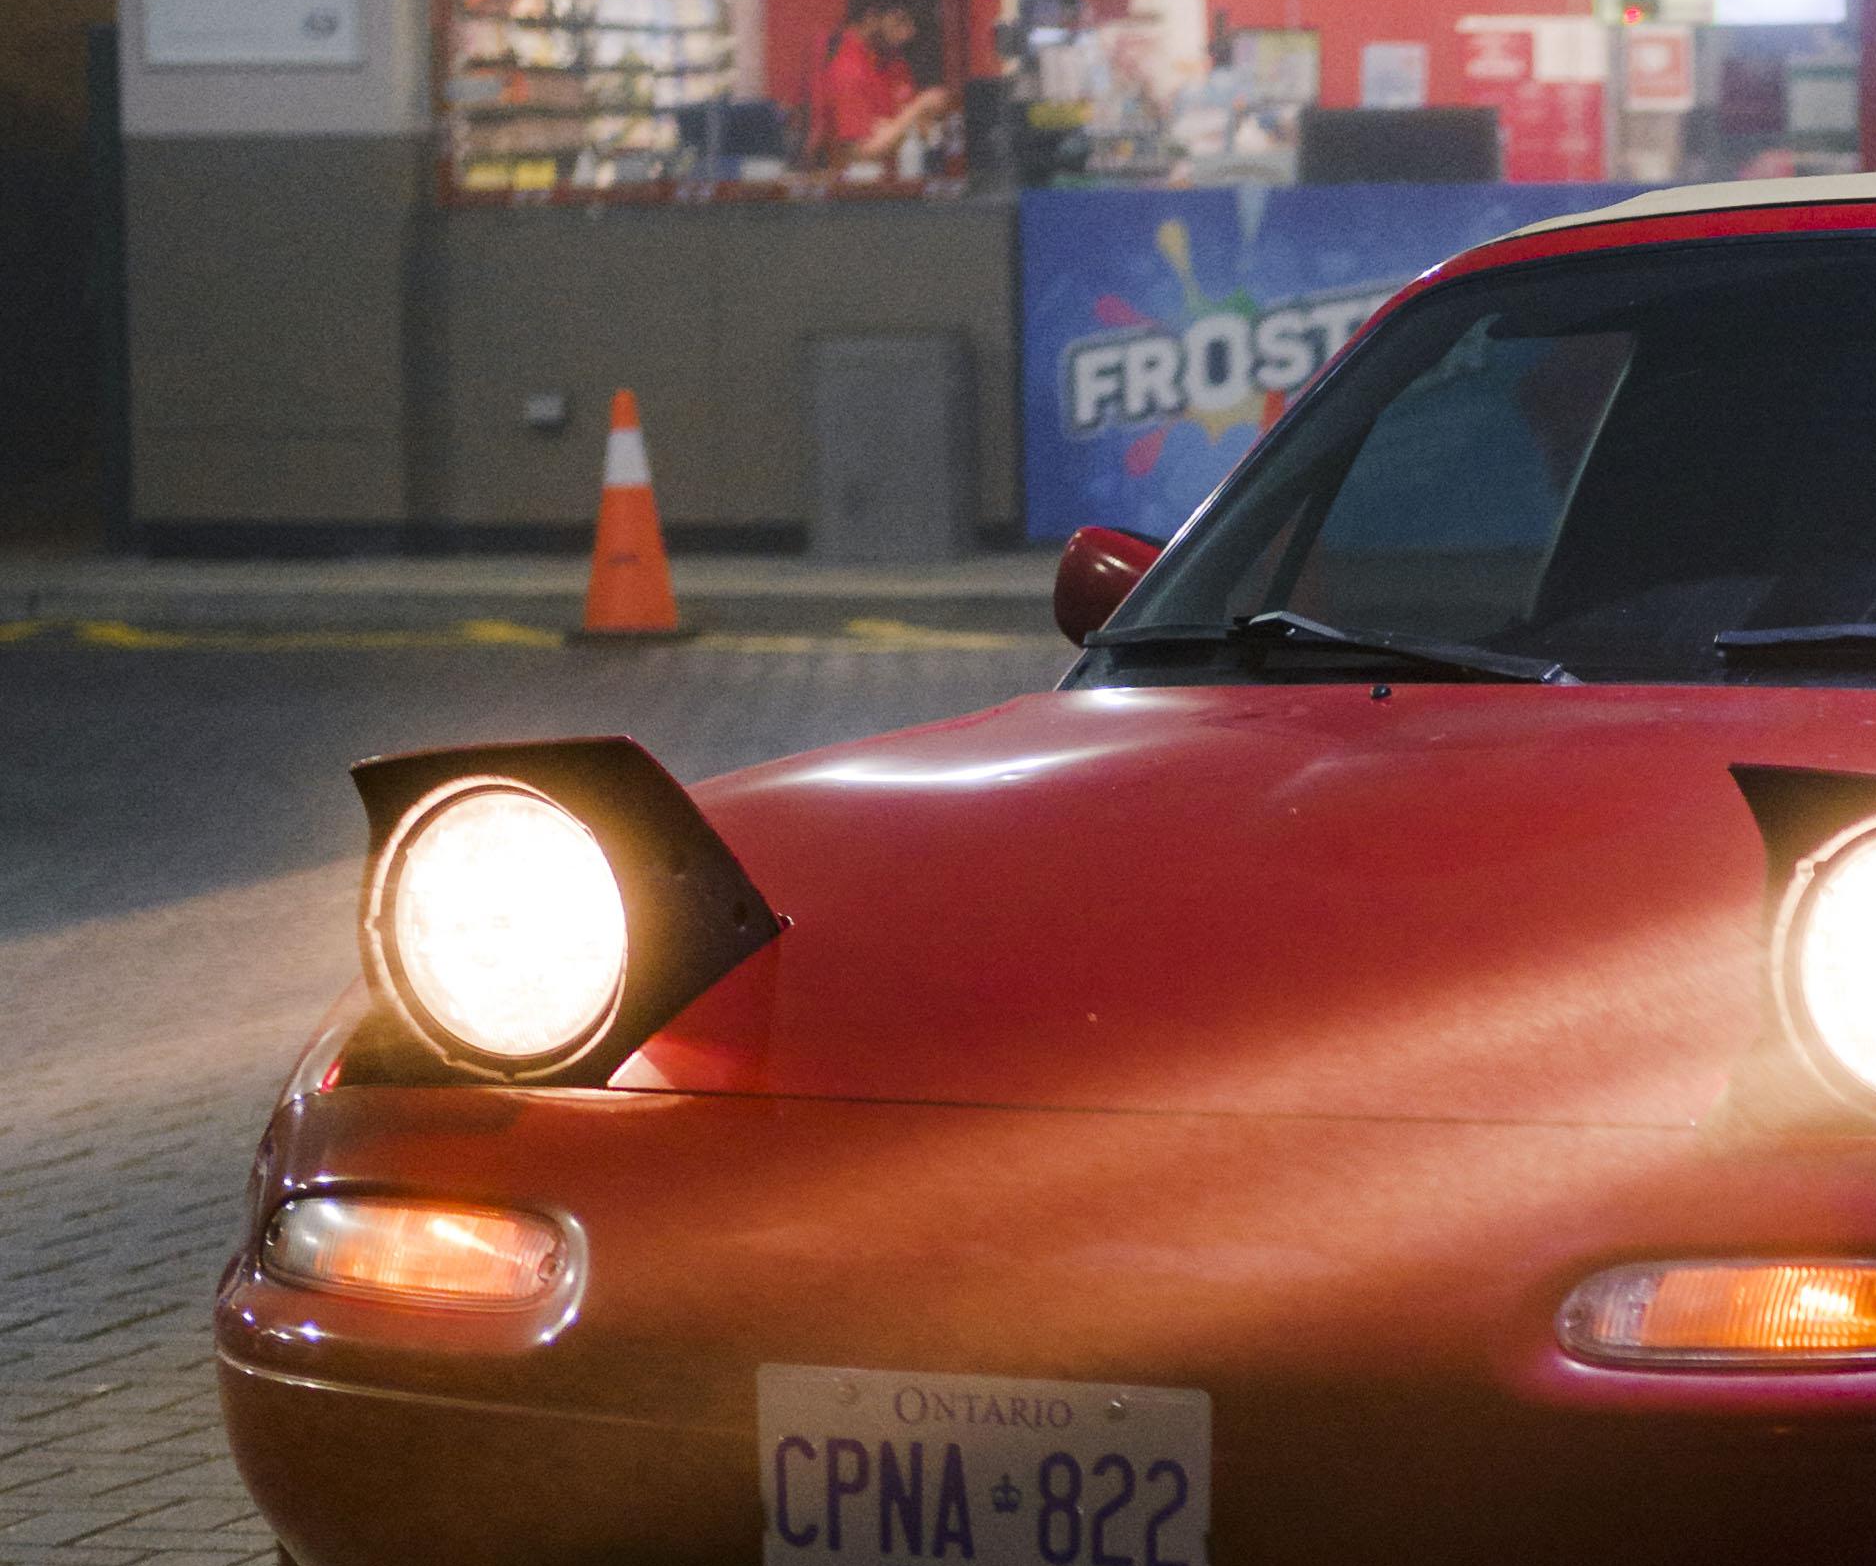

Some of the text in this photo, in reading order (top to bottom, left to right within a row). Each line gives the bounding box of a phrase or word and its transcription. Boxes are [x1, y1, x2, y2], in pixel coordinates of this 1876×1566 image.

[1071, 294, 1392, 428] FROST
[894, 1385, 1073, 1430] ONTARIO
[775, 1435, 975, 1560] CPNA
